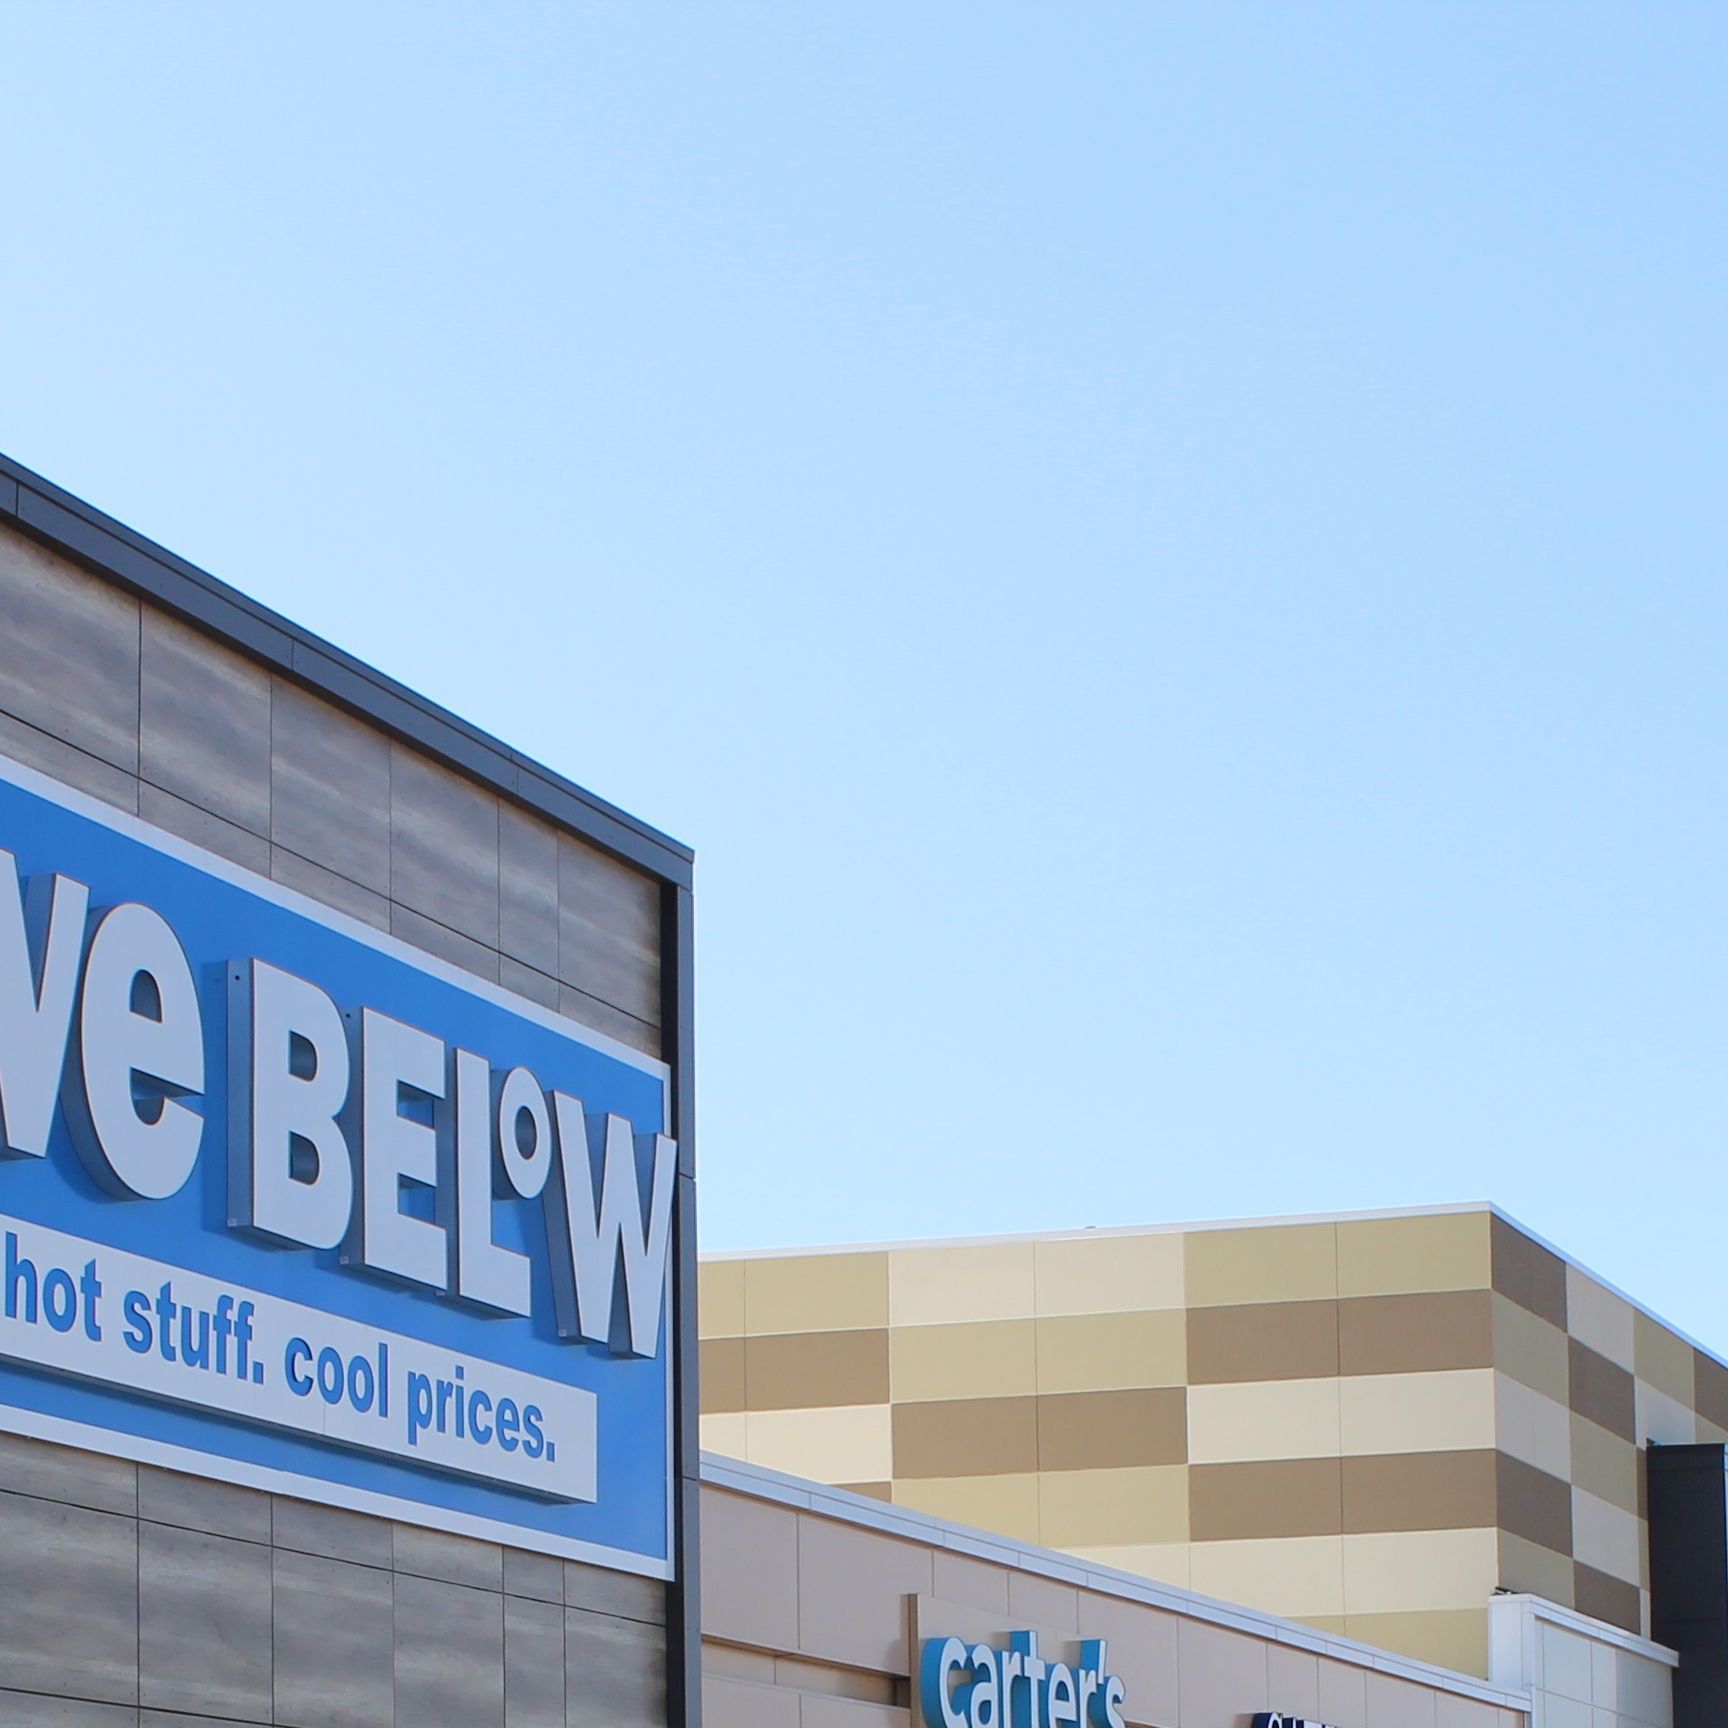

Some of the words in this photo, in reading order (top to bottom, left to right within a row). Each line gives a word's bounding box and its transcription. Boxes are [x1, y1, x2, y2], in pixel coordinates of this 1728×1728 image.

[227, 958, 678, 1360] BELOW
[3, 1231, 103, 1341] hot
[123, 1279, 265, 1386] stuff.
[284, 1336, 389, 1421] cool
[406, 1366, 557, 1463] prices.
